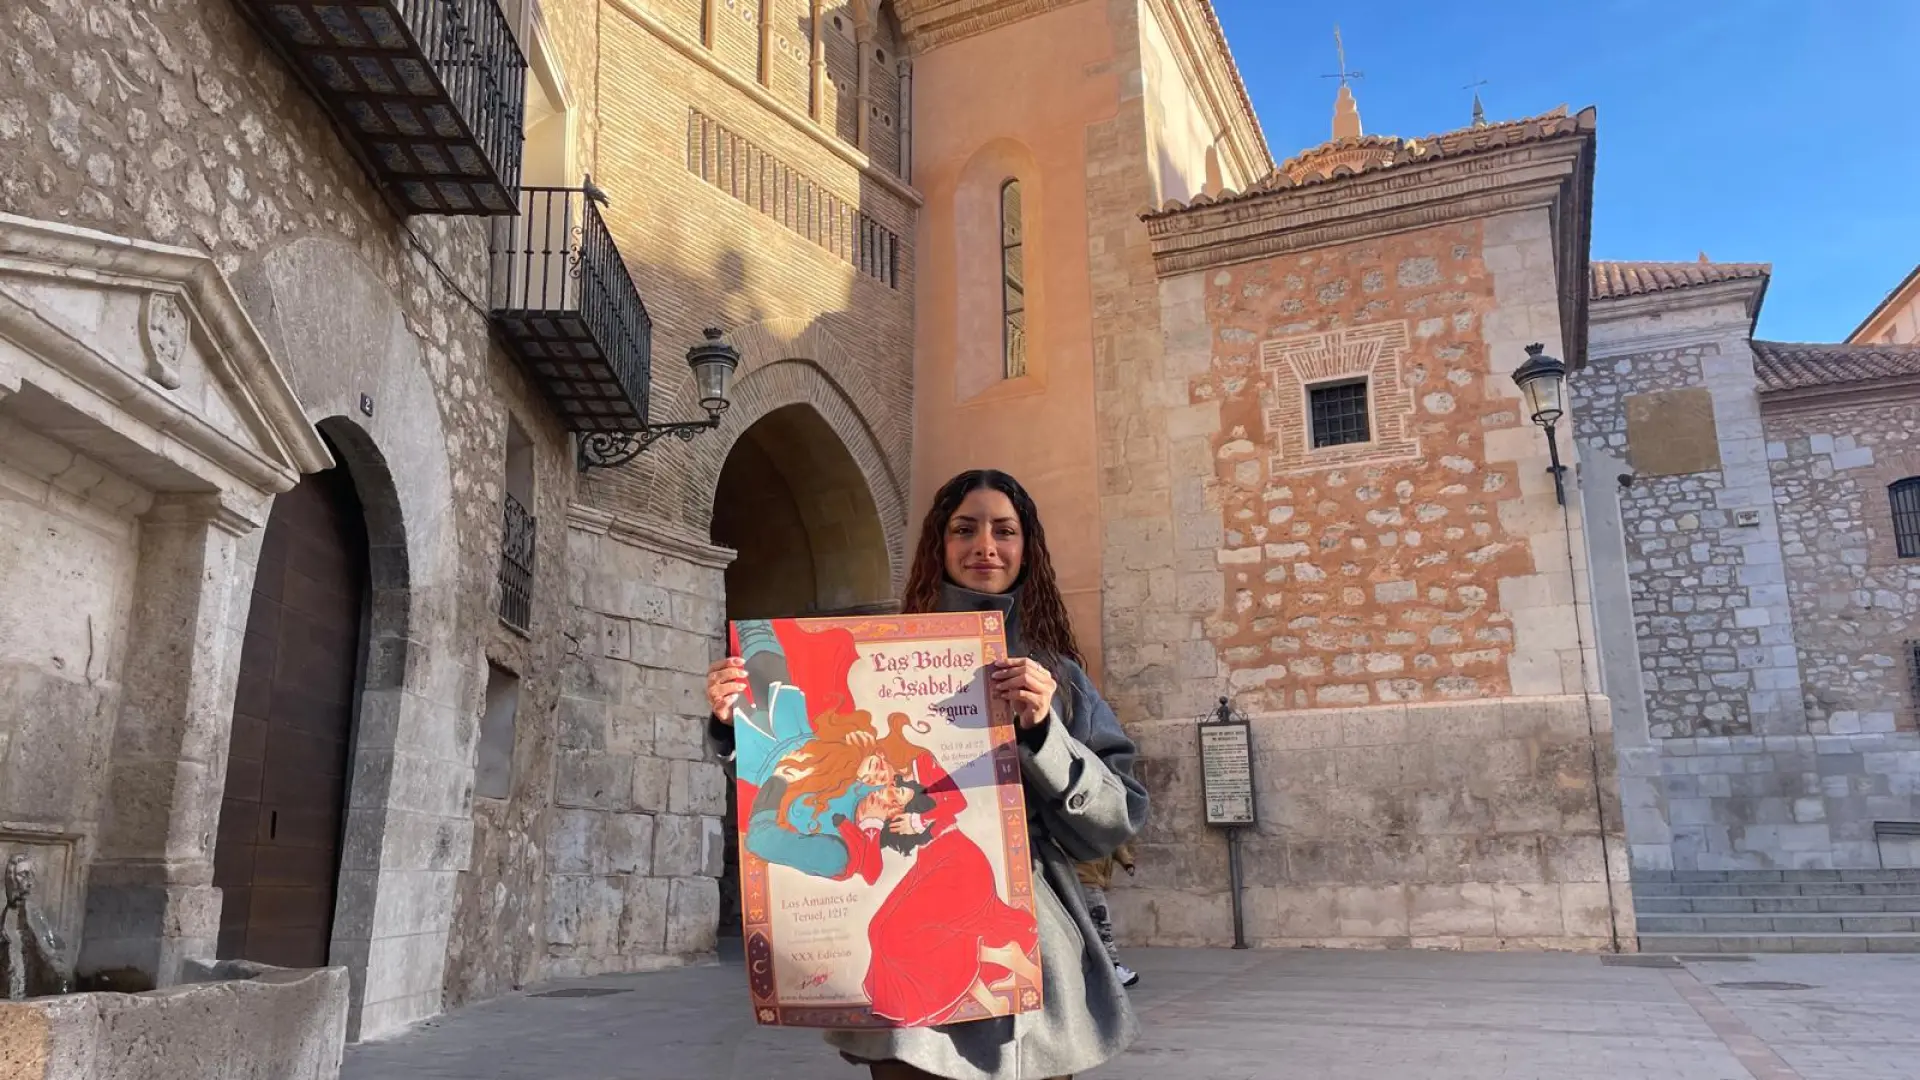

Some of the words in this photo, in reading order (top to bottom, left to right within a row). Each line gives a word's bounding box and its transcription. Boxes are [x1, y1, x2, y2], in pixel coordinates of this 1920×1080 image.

[871, 652, 909, 674] Las
[912, 648, 975, 672] Bodas
[878, 685, 892, 698] de
[893, 674, 953, 700] Isabel
[956, 681, 969, 694] de
[927, 703, 978, 722] Segura
[781, 899, 801, 910] Los
[802, 895, 845, 907] Amantes
[846, 892, 859, 903] de
[792, 910, 826, 923] Teruel,
[828, 907, 848, 919] 1217
[791, 951, 814, 962] XXX
